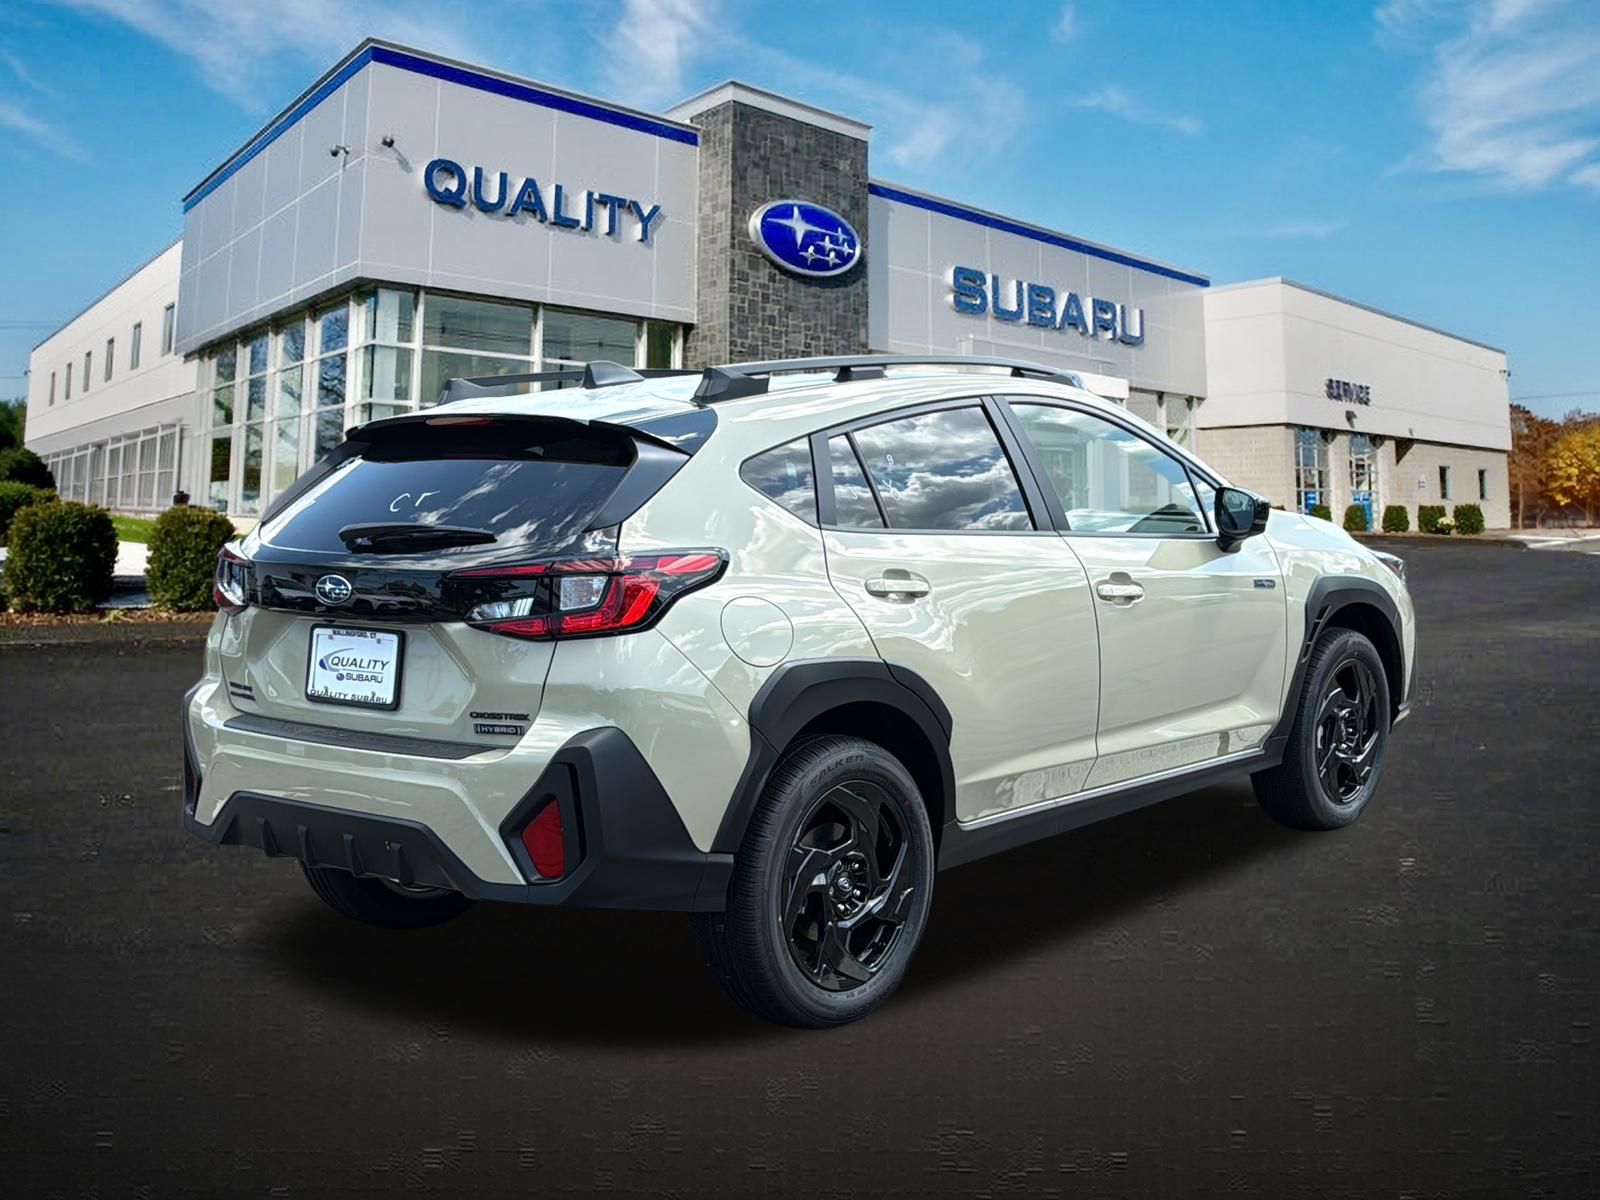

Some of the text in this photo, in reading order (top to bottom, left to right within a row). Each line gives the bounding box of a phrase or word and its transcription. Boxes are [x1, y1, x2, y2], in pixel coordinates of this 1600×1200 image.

[424, 158, 662, 242] QUALITY
[952, 265, 1145, 346] SUBARU
[1325, 378, 1371, 406] SERVICE
[330, 656, 390, 671] QUALITY
[345, 672, 384, 684] SUBARU
[310, 688, 388, 704] QUALITY SUBARU
[469, 711, 531, 721] CROSSTREK
[481, 725, 516, 733] HYBRID
[809, 754, 865, 786] FALKEN
